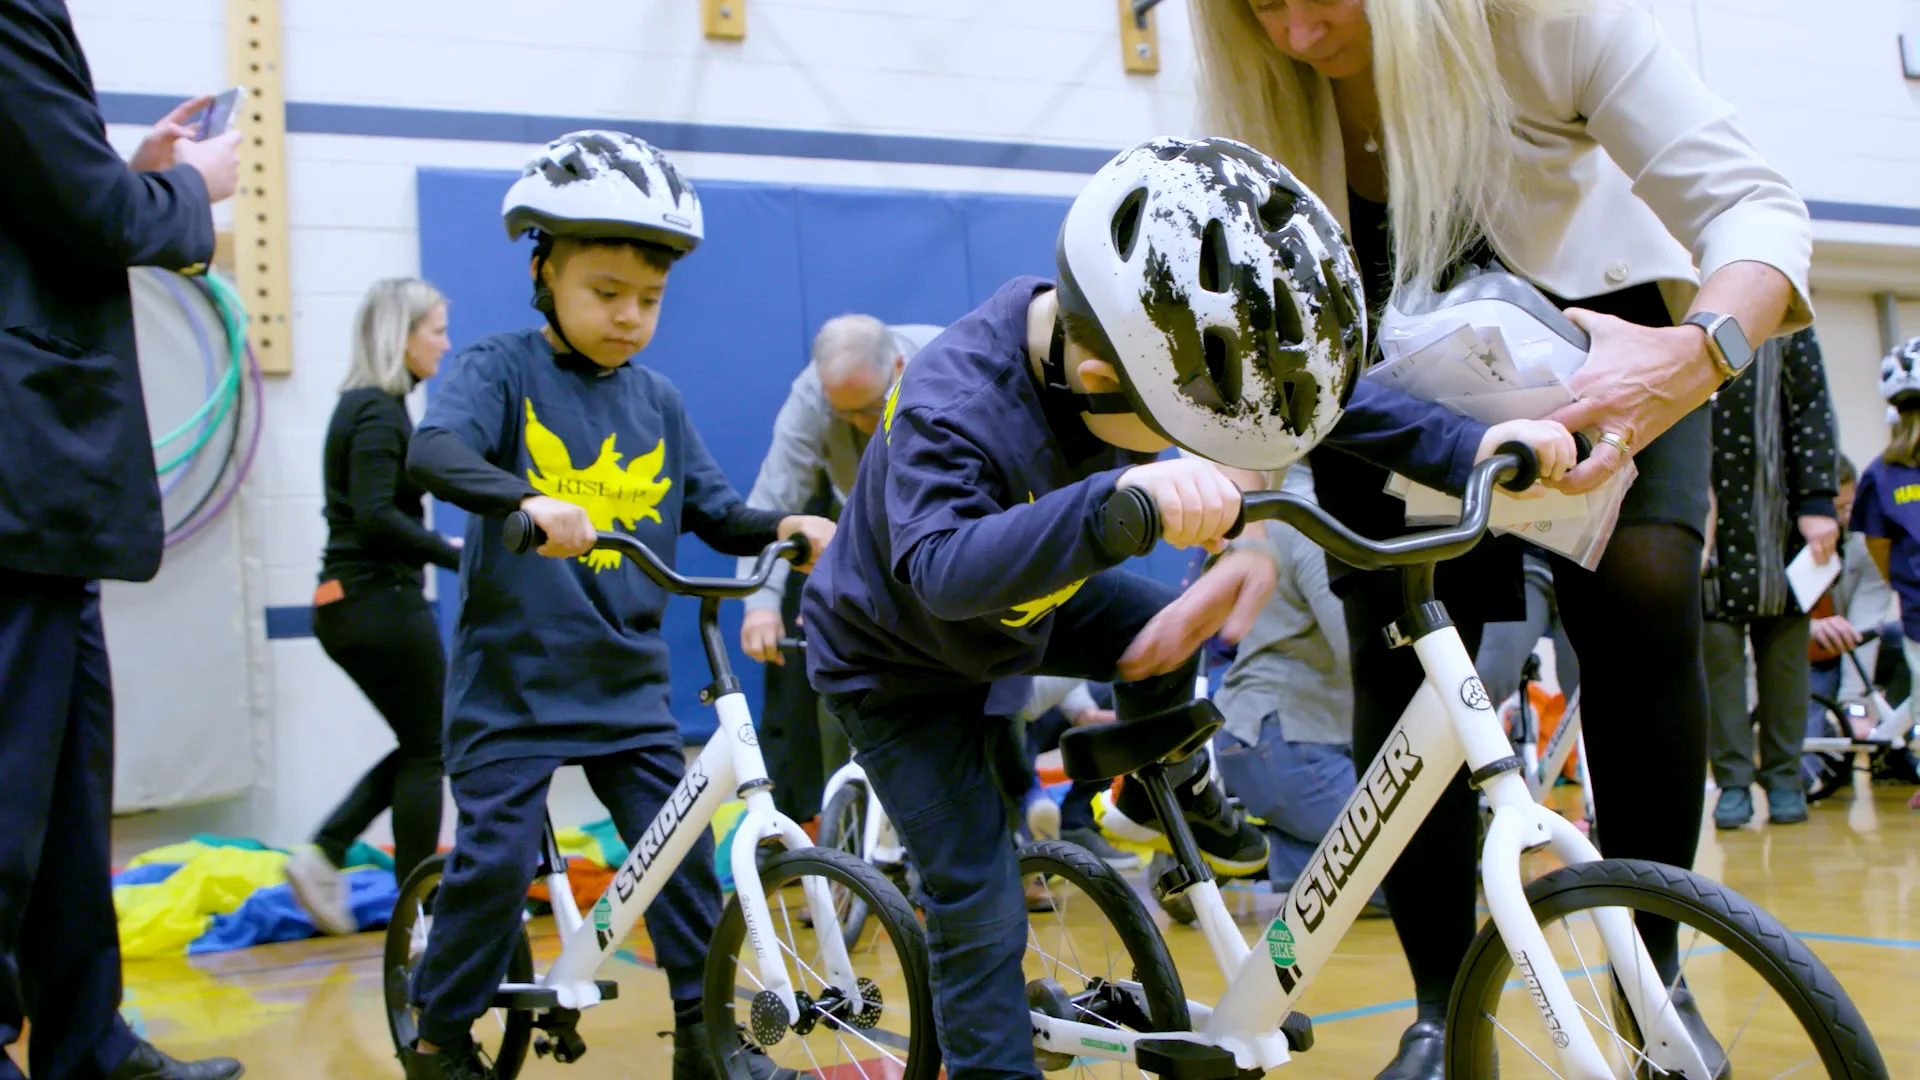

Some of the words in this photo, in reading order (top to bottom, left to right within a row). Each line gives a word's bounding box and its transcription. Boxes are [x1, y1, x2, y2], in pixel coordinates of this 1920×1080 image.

[557, 478, 610, 497] RISE
[615, 759, 709, 904] STRIDER
[1296, 730, 1424, 934] STRIDER
[1269, 943, 1295, 957] BIKE
[1271, 927, 1291, 942] KIDS
[1513, 949, 1561, 1030] STRIDER
